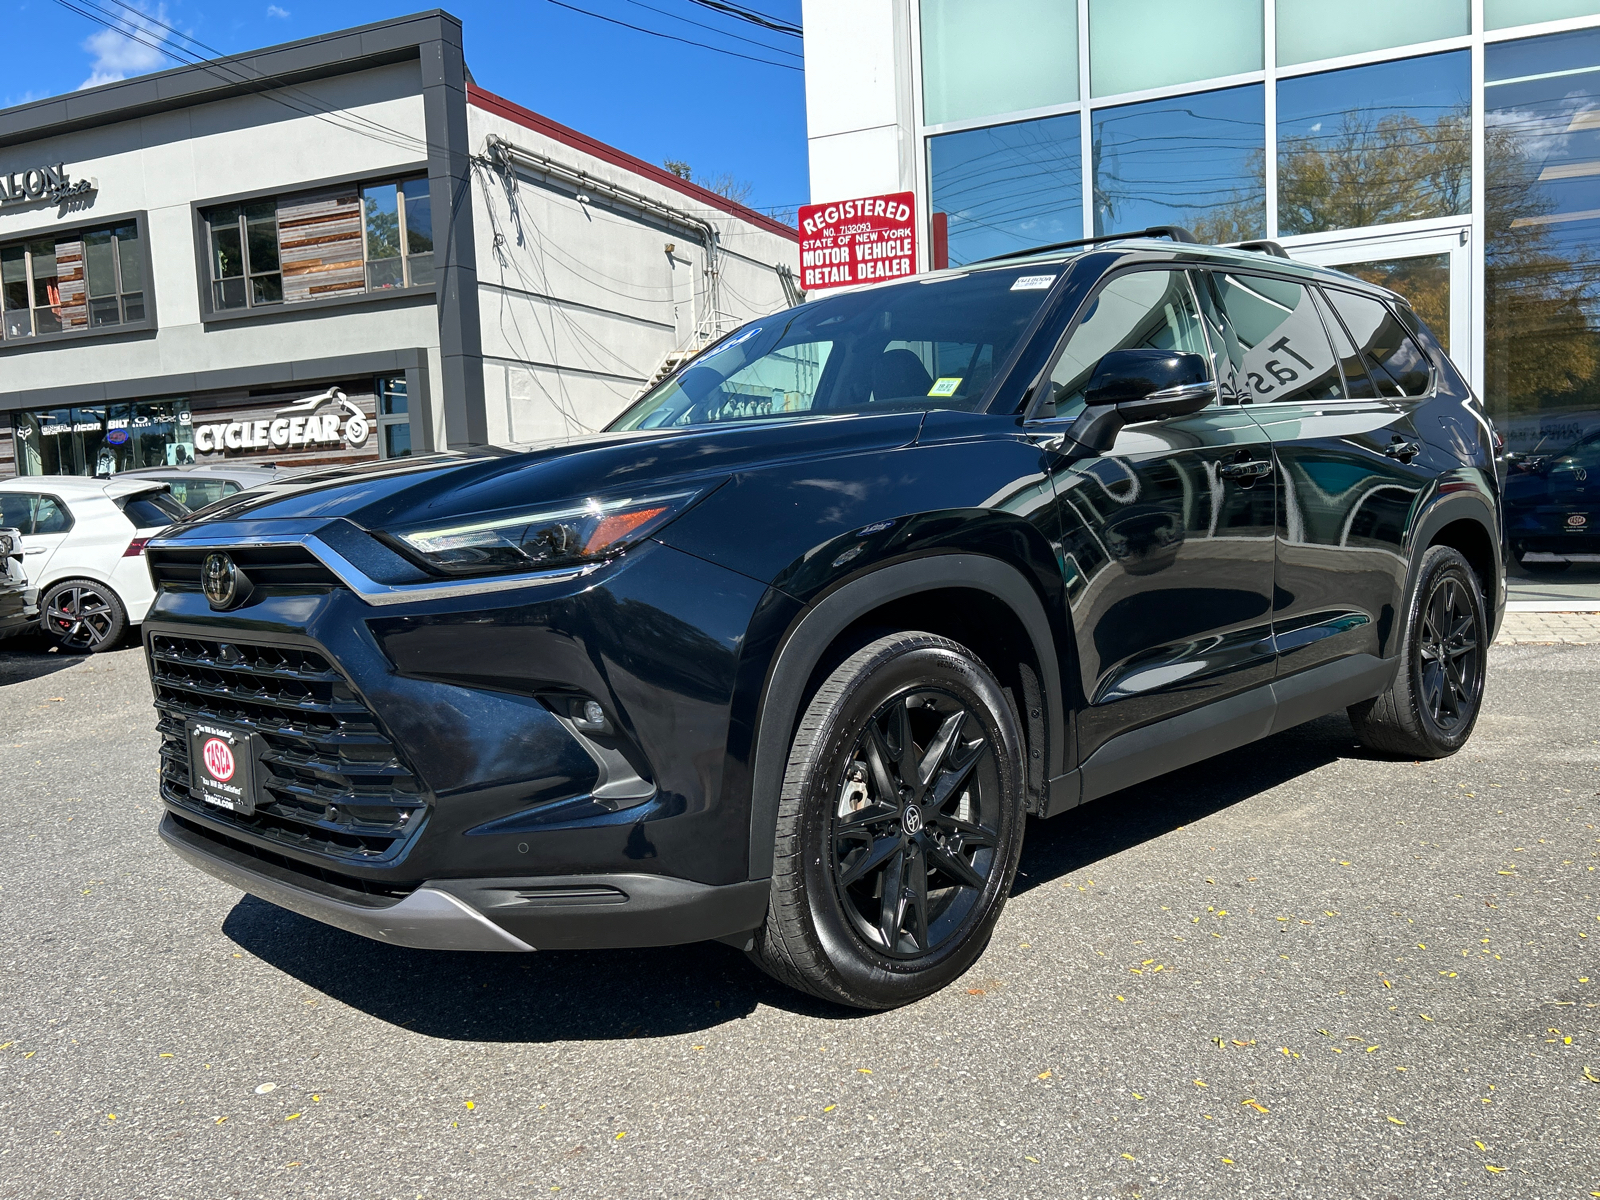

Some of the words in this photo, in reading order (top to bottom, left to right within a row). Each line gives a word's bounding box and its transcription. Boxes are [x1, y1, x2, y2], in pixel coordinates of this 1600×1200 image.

[803, 200, 910, 235] REGISTERED
[823, 228, 836, 237] NO.
[840, 222, 871, 235] 7132093
[803, 238, 834, 249] STATE
[837, 235, 851, 245] OF
[855, 232, 878, 243] NEW
[882, 228, 912, 239] YORK
[803, 246, 850, 267] MOTOR
[855, 238, 912, 260] VEHICLE
[805, 265, 852, 285] RETAIL
[857, 258, 910, 280] DEALER
[107, 419, 129, 429] BILT
[207, 743, 231, 775] TASCA
[204, 794, 234, 811] TASCA.COM
